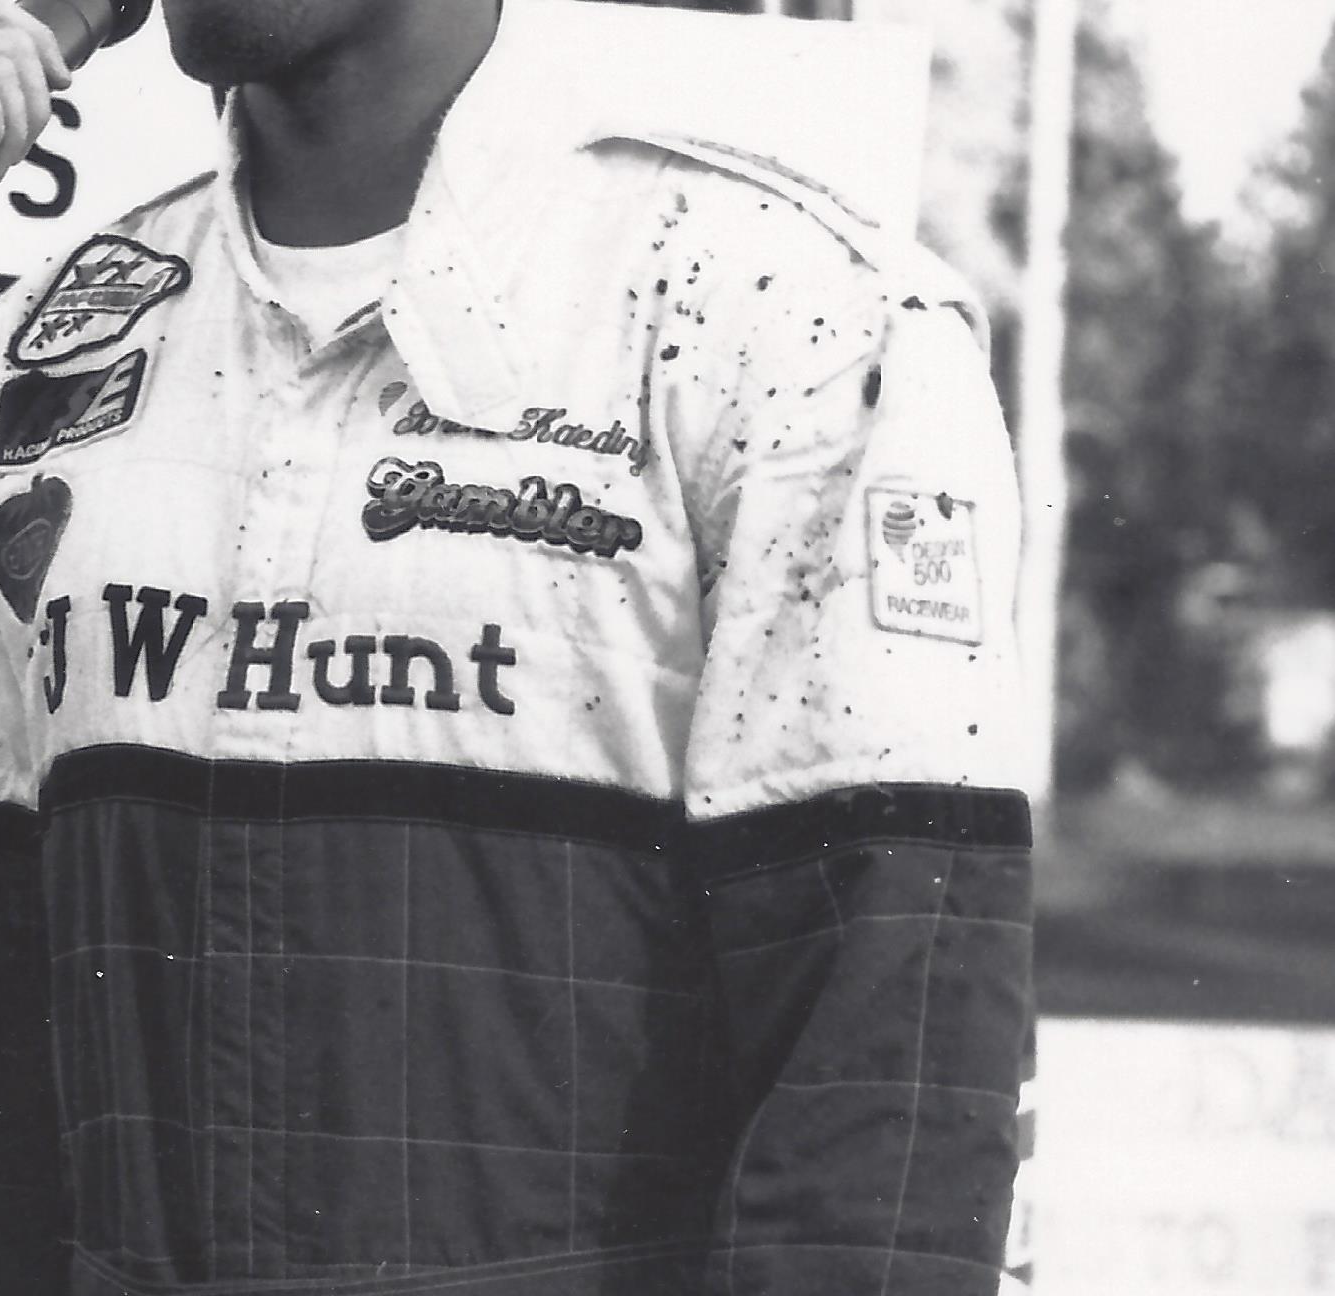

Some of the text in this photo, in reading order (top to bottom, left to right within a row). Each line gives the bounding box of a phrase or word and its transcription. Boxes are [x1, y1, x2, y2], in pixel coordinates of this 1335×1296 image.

[362, 456, 643, 558] Gambler
[913, 560, 952, 586] 500
[102, 583, 208, 701] W
[217, 599, 517, 716] Hunt
